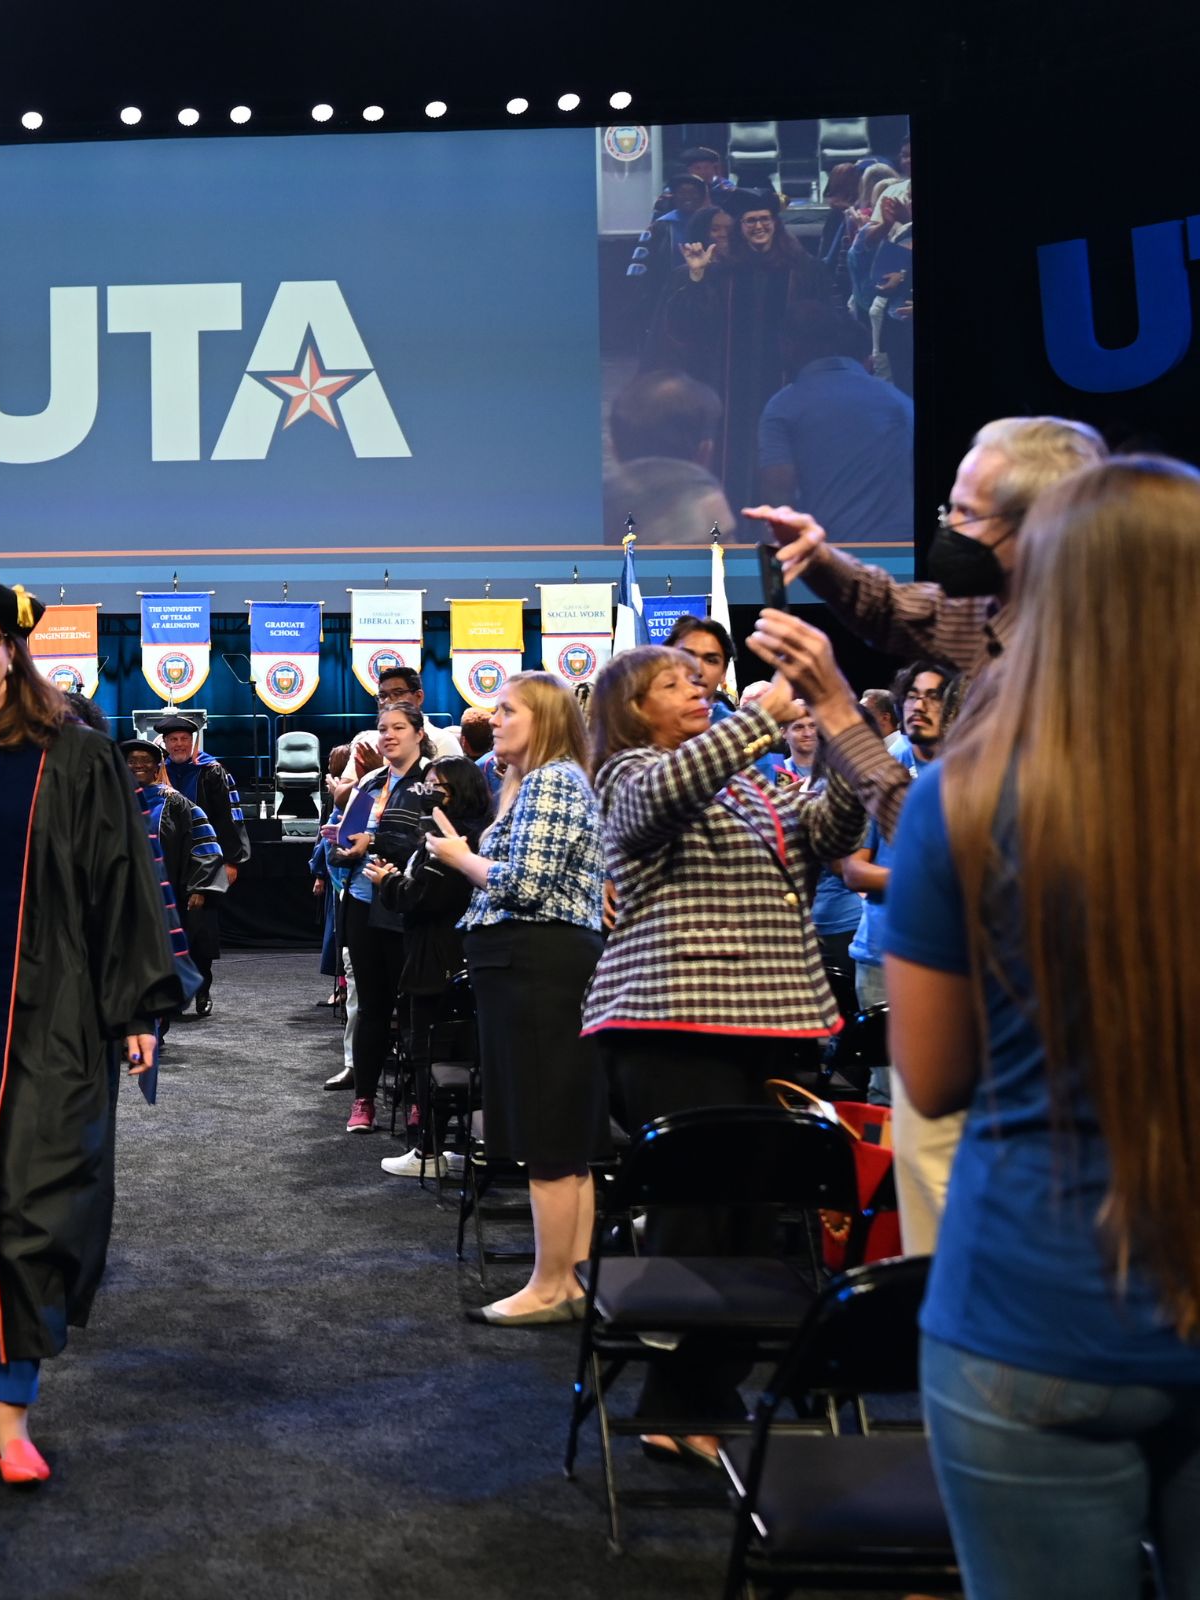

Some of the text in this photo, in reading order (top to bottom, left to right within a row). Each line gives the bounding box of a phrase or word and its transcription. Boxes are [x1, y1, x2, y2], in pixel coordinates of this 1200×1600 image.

[1036, 214, 1200, 393] U
[547, 610, 578, 618] SOCIAL
[359, 617, 392, 625] LIBERAL
[648, 617, 679, 627] STUD
[269, 629, 301, 637] SCHOOL
[468, 627, 506, 635] SCIENCE
[34, 632, 91, 641] ENGINEERING
